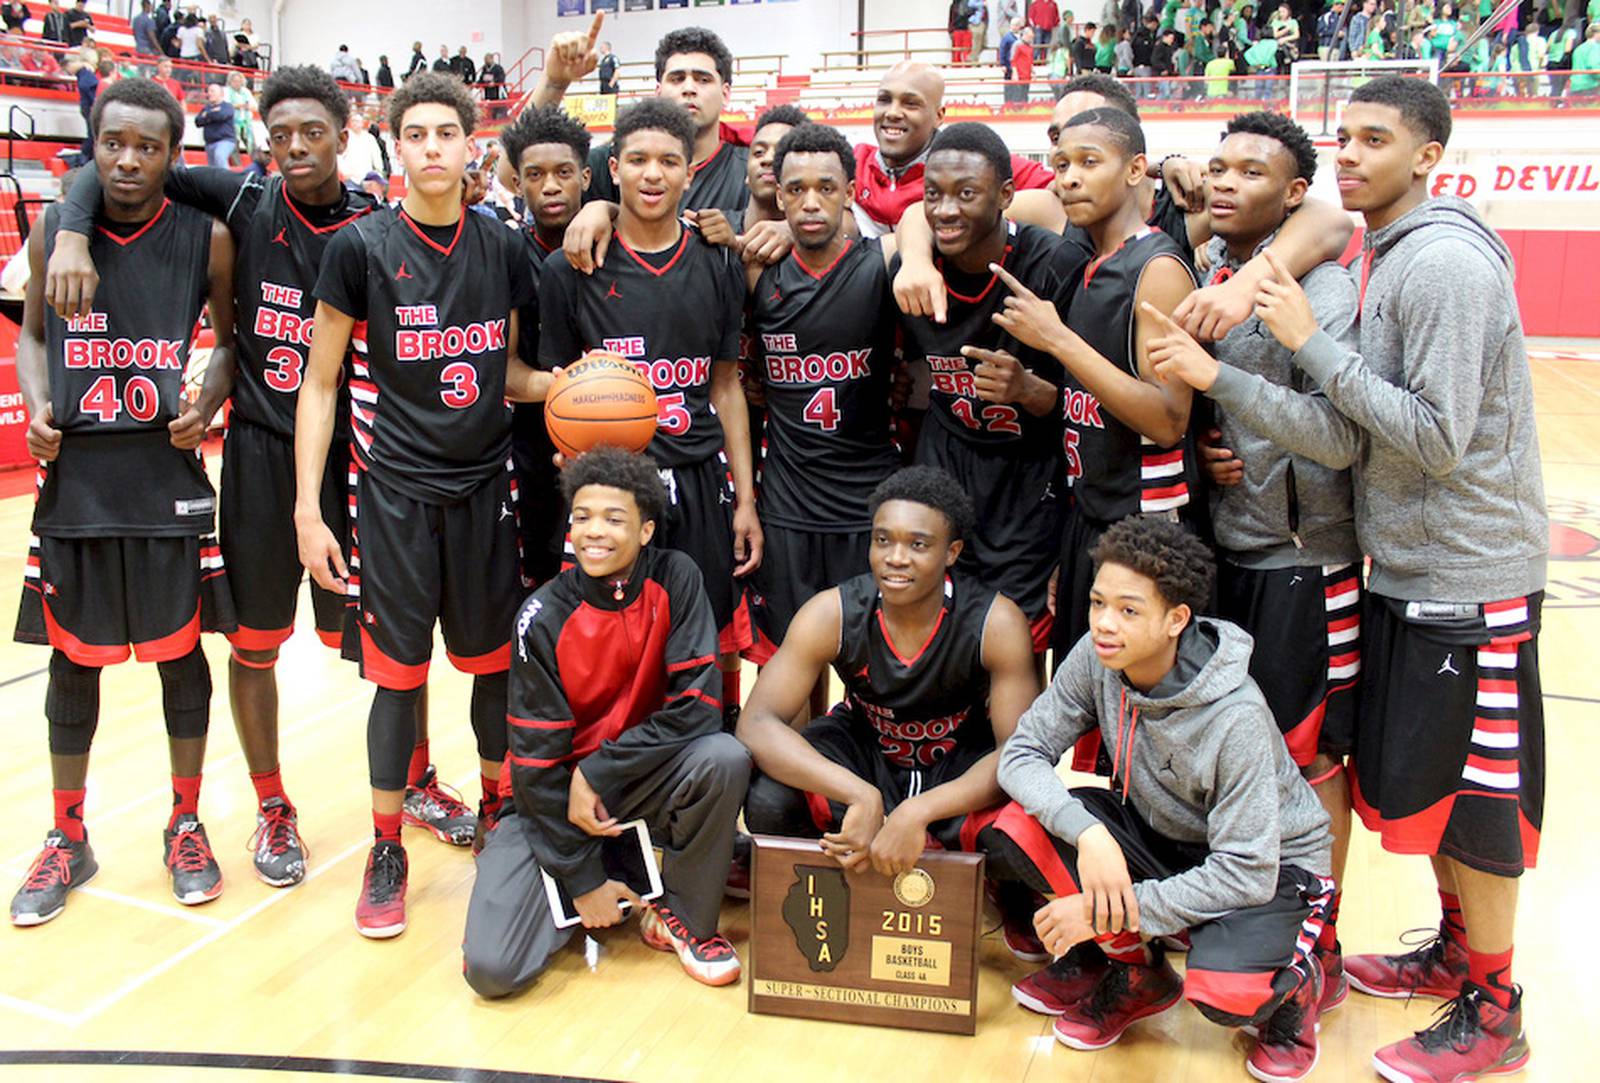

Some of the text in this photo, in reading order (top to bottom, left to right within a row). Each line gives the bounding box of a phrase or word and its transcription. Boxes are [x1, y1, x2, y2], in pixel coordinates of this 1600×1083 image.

[1430, 164, 1600, 199] ED DEVIL
[261, 282, 303, 309] THE
[67, 313, 108, 332] THE
[254, 306, 315, 347] BRO
[395, 305, 438, 326] THE
[396, 319, 506, 361] BROOK
[603, 336, 645, 356] THE
[762, 334, 798, 352] THE
[65, 338, 184, 370] BROOK
[765, 348, 873, 384] BROOK
[926, 355, 969, 371] THE
[80, 375, 160, 422] 40
[440, 362, 480, 409] 3
[803, 387, 841, 431] 4
[878, 735, 958, 767] 20
[881, 910, 943, 936] 2015
[885, 954, 938, 969] BASKETBALL
[900, 944, 924, 956] BOYS
[895, 970, 916, 980] CLASS
[883, 994, 958, 1013] CHAMPIONS
